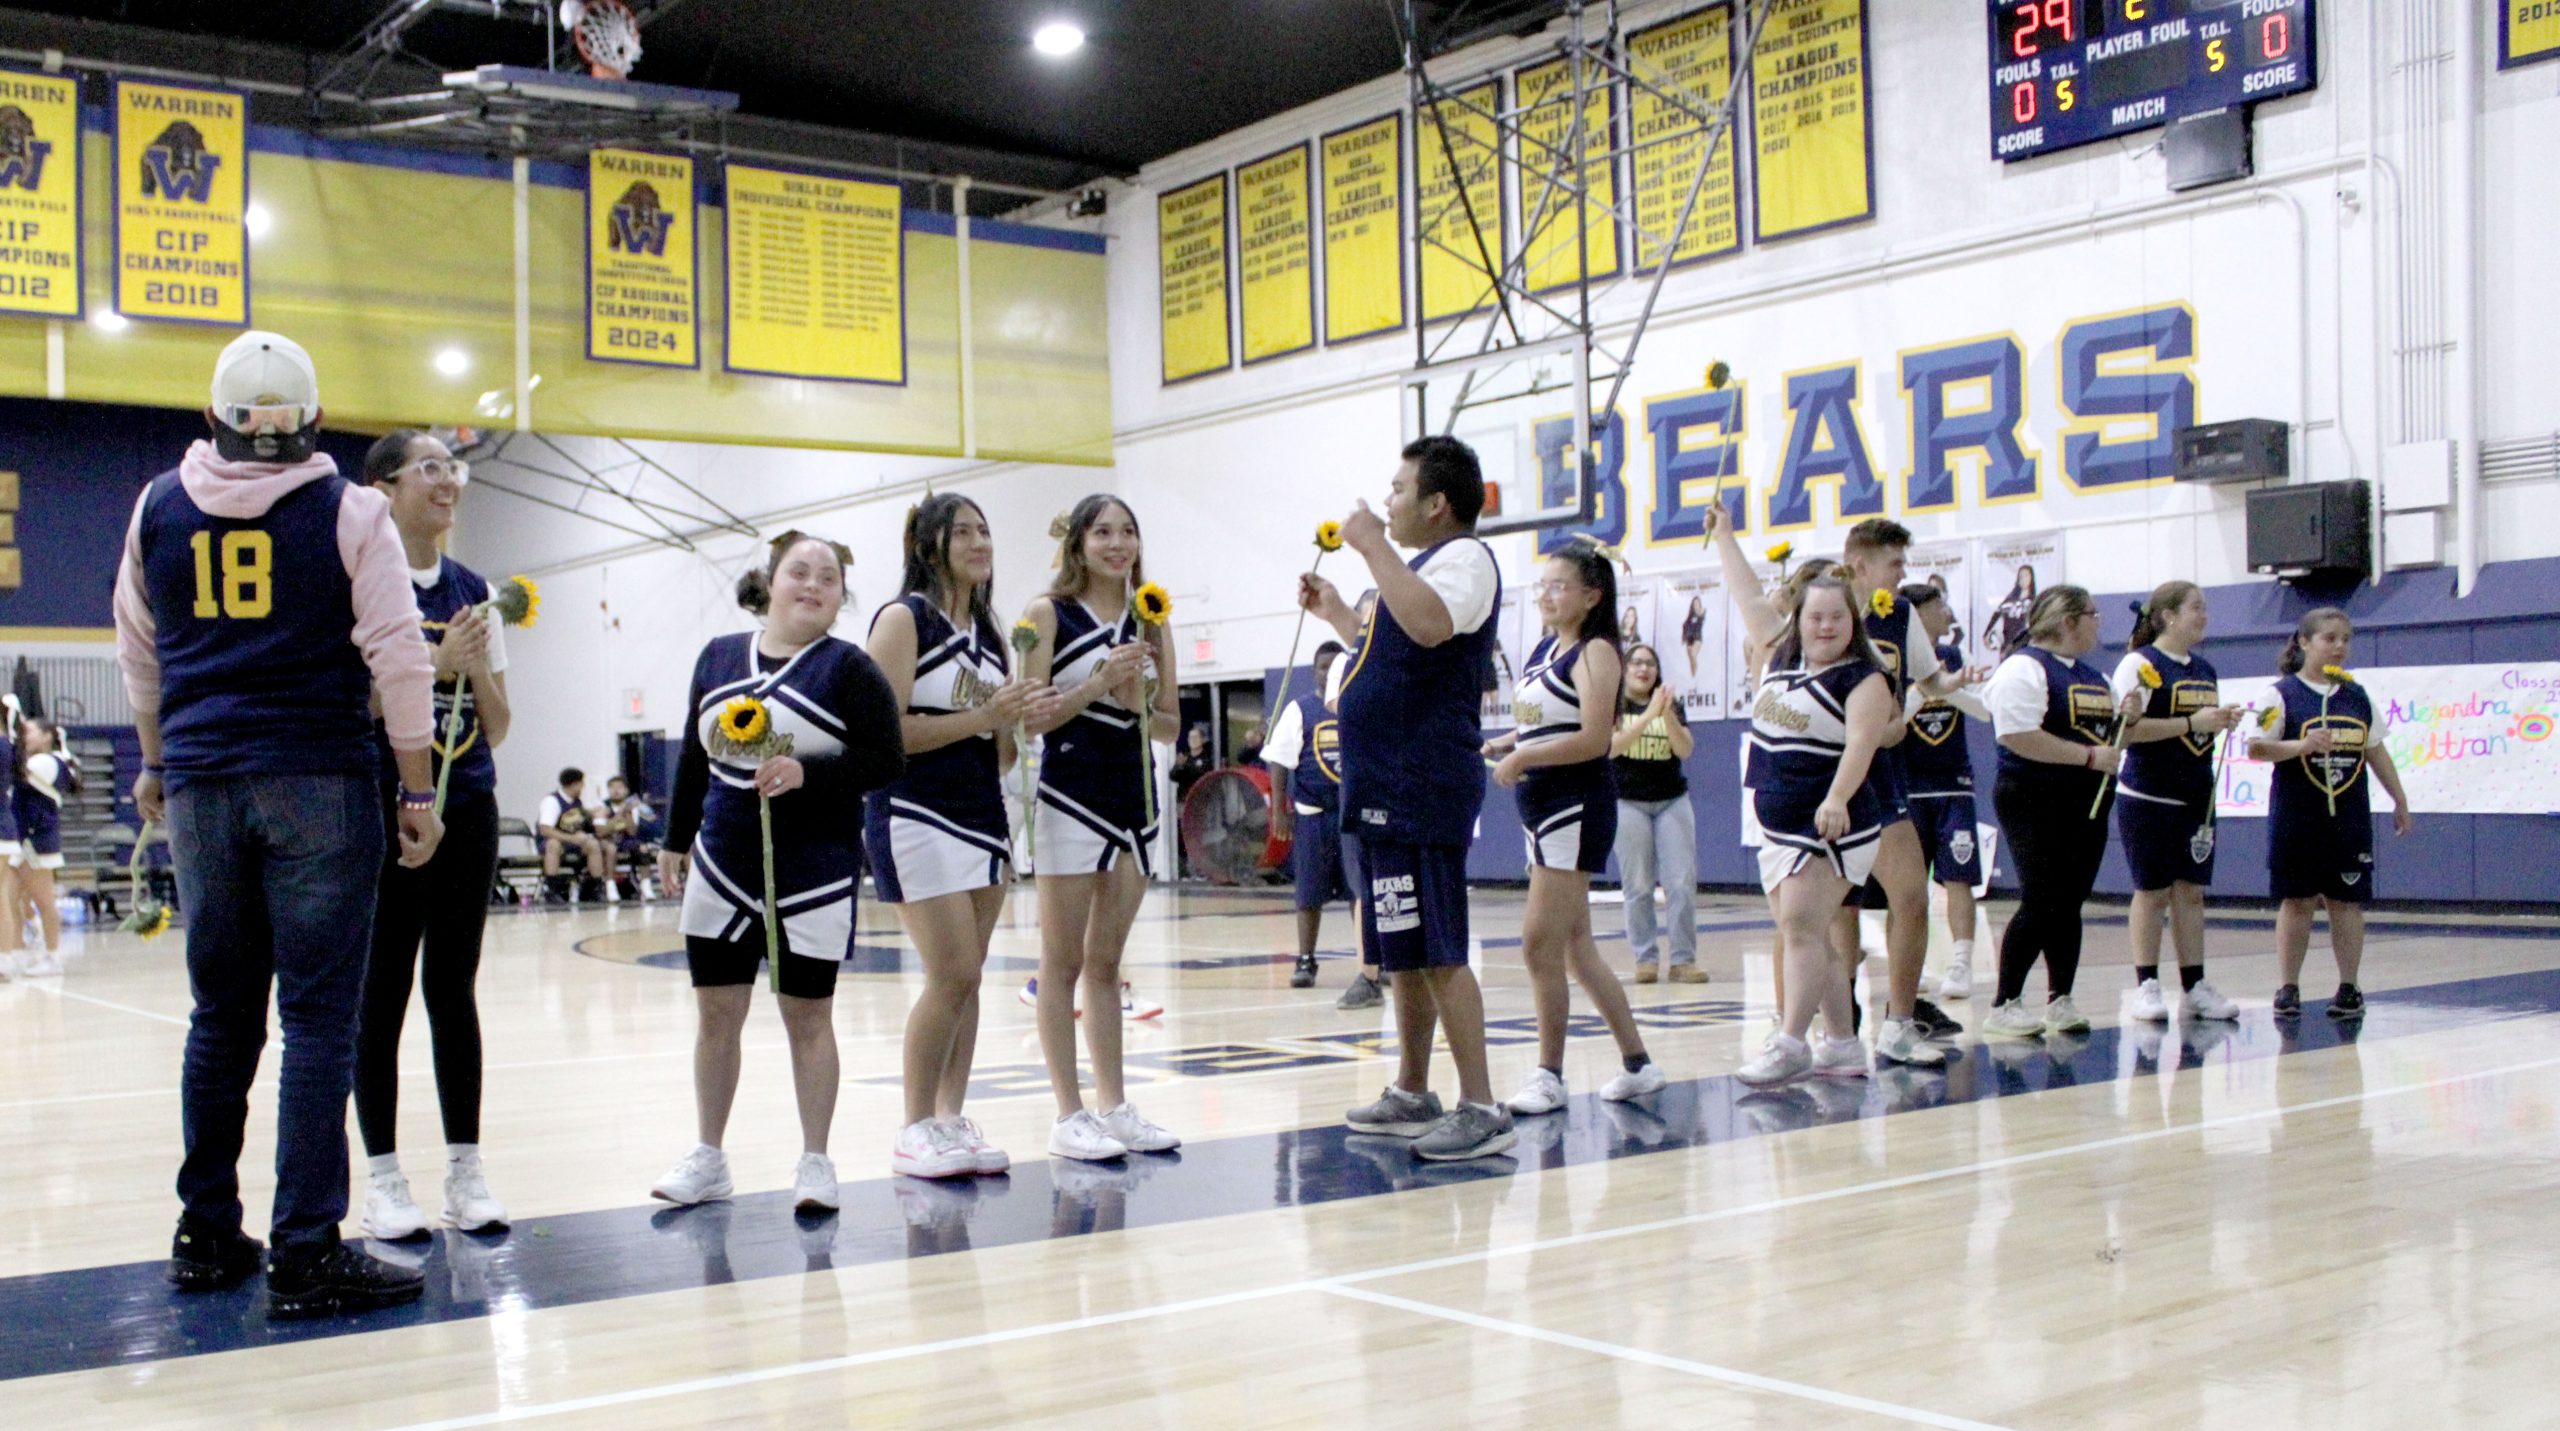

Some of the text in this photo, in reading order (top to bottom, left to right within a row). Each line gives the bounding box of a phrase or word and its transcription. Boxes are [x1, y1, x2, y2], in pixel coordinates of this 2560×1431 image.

[1638, 15, 1721, 58] WARREN
[2014, 0, 2071, 57] 29
[2086, 19, 2190, 62] PLAYER FOUL
[2262, 13, 2288, 59] 0
[1776, 42, 1838, 75] LEAGUE
[1996, 59, 2041, 85] FOULS
[1759, 58, 1857, 99] CHAMPIONS
[2242, 62, 2297, 94] SCORE
[128, 91, 234, 119] WARREN
[2014, 81, 2036, 123] 0
[2112, 97, 2165, 126] MATCH
[1329, 126, 1393, 156] WARREN
[1998, 127, 2043, 154] SCORE
[602, 153, 684, 179] WARREN
[1340, 181, 1382, 206] LEAGUE
[815, 199, 895, 221] CHAMPIONS
[1328, 195, 1395, 227] CHAMPIONS
[125, 252, 239, 278] CHAMPIONS
[145, 281, 218, 307] 2018
[597, 301, 688, 324] CHAMPIONS
[608, 326, 677, 350] 2024
[1532, 298, 2200, 562] BEARS
[190, 530, 273, 618] 18
[2502, 669, 2547, 690] Class
[2386, 691, 2512, 729] Alejandra
[2392, 730, 2508, 769] Beltran
